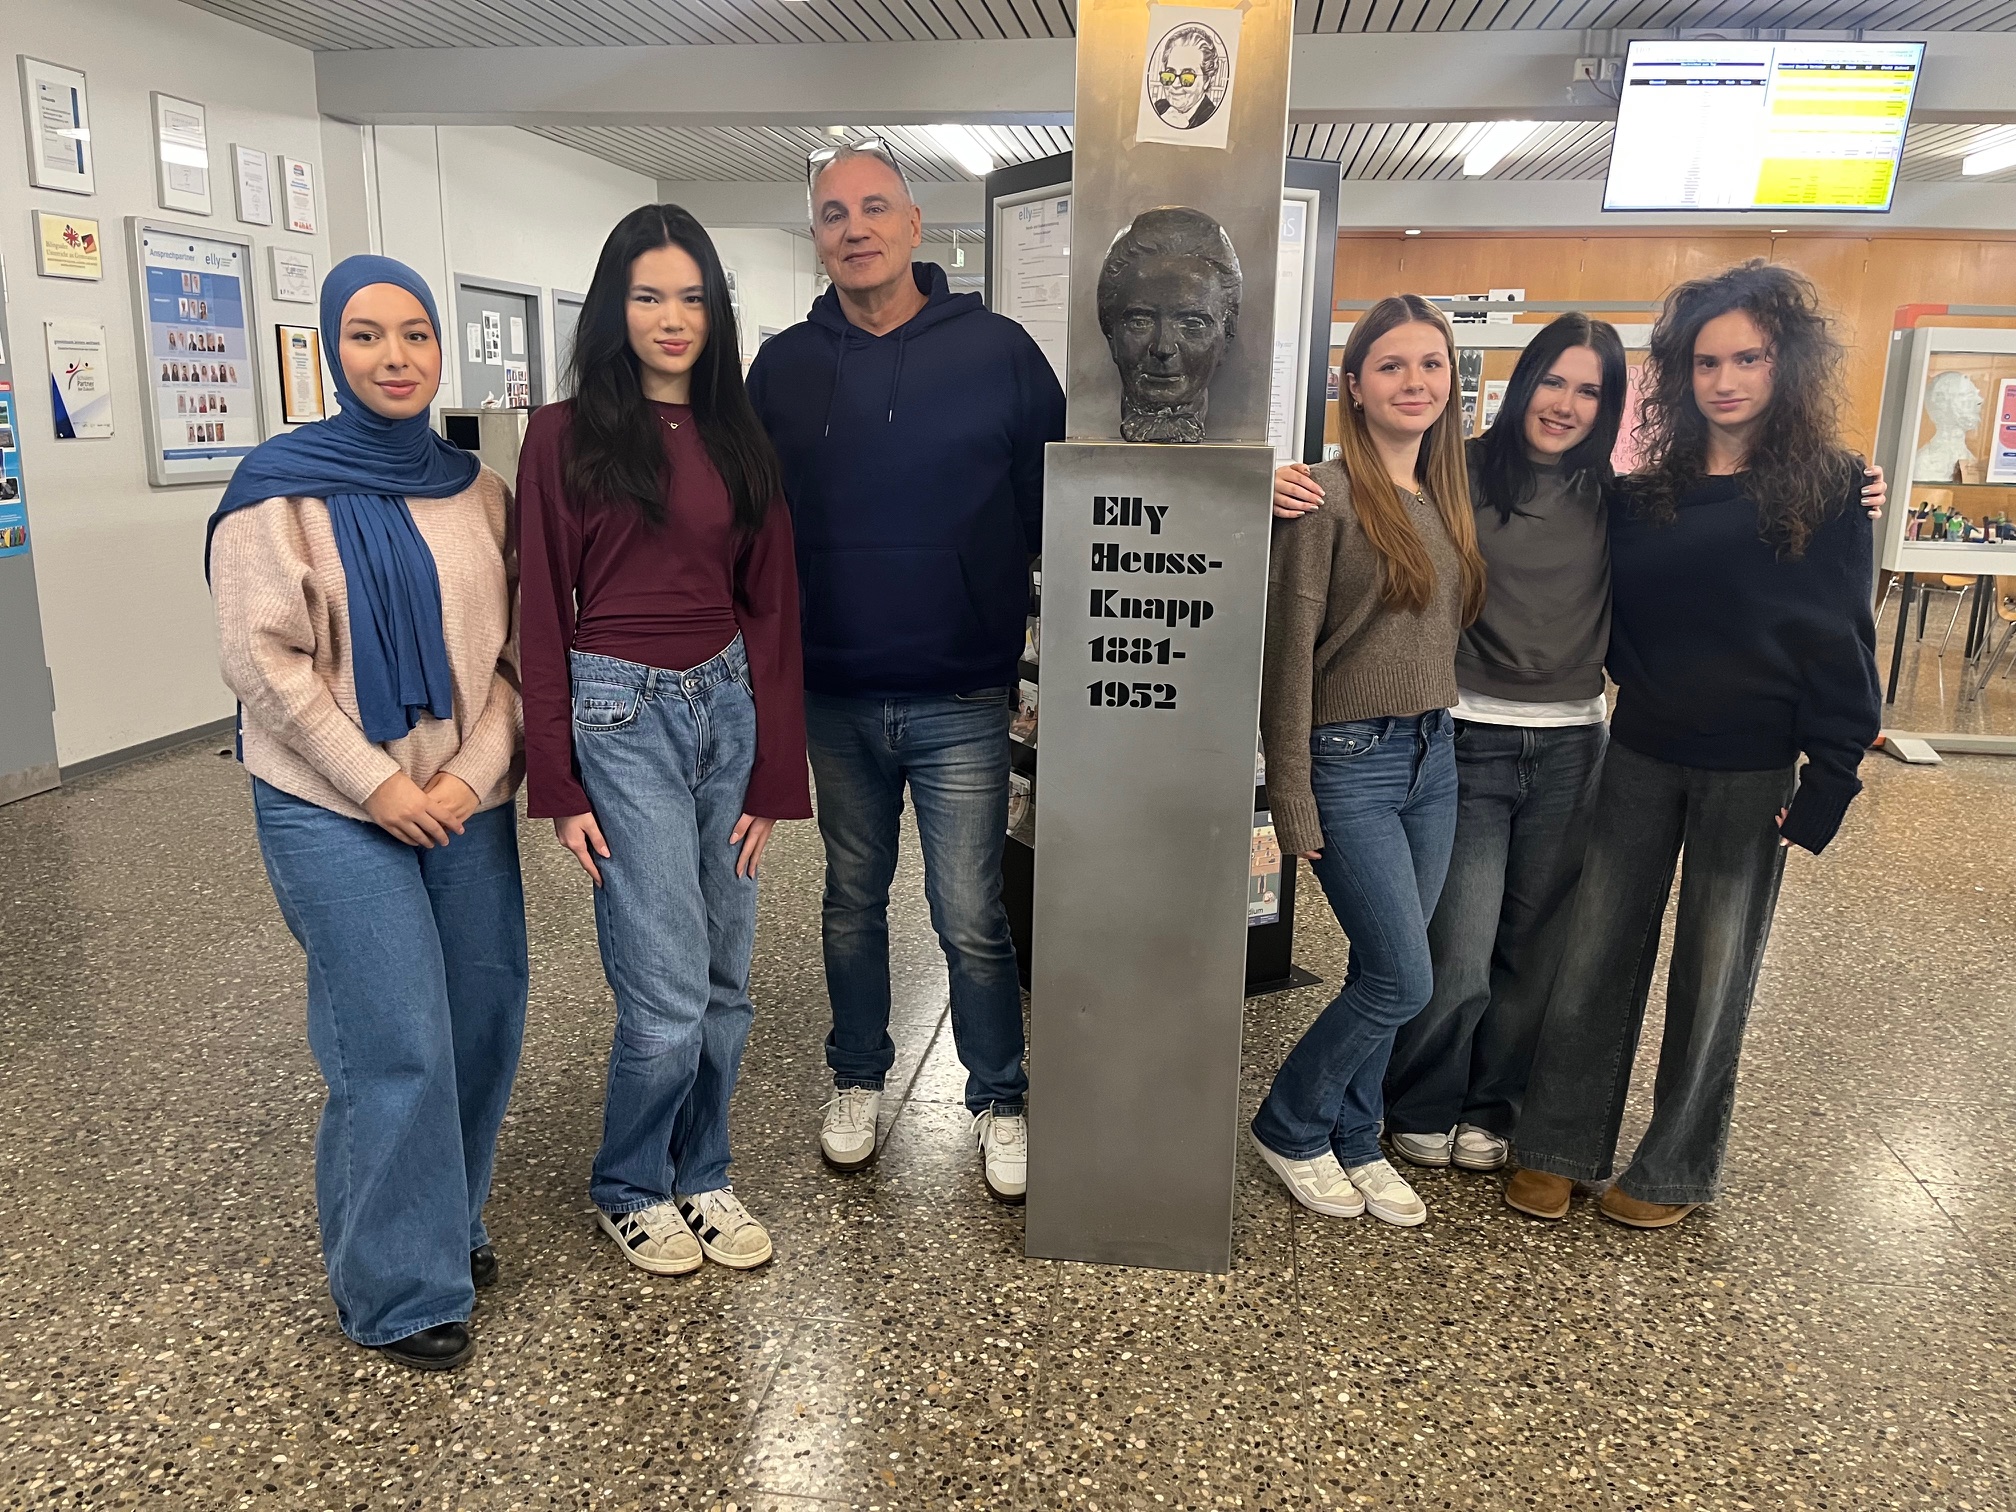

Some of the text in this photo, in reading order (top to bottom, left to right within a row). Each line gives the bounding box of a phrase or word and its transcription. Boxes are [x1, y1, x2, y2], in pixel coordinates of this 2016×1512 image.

[1018, 206, 1032, 222] elly
[149, 248, 195, 262] Ansprechpartner
[205, 253, 221, 269] elly
[1093, 496, 1169, 535] Elly
[1091, 542, 1223, 575] Heuss-
[1089, 588, 1214, 628] Knapp
[1088, 635, 1187, 665] 1881-
[1086, 680, 1178, 709] 1952
